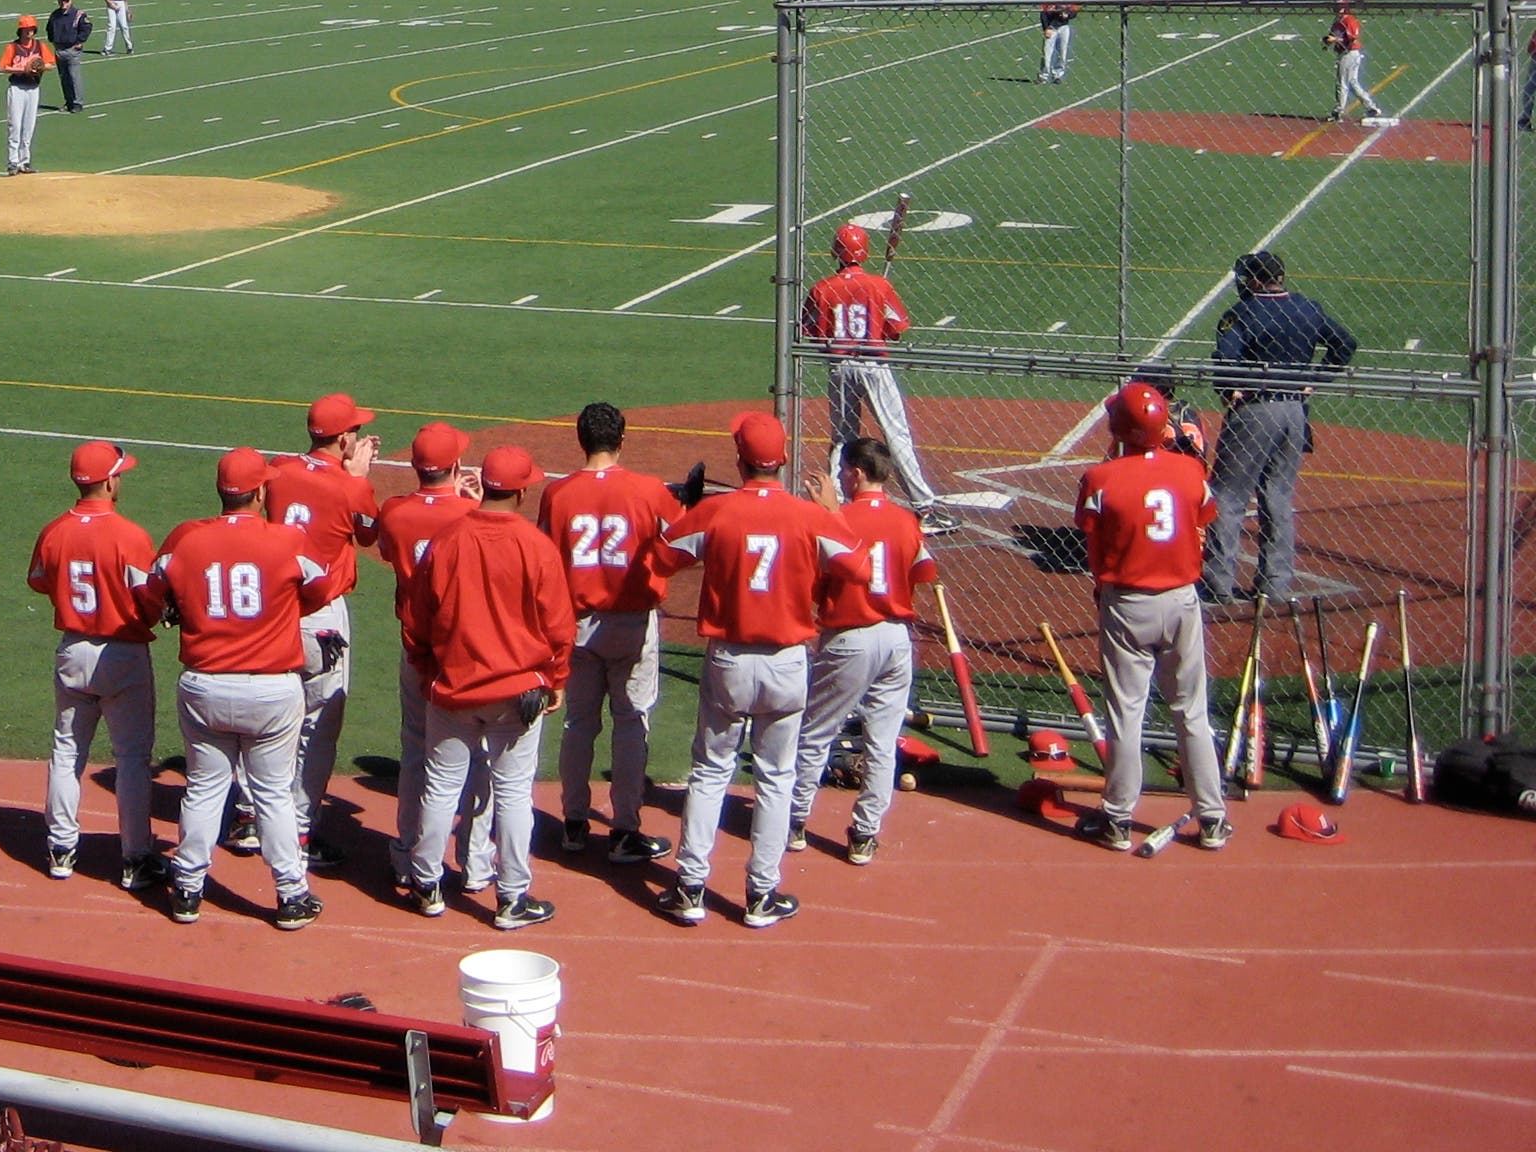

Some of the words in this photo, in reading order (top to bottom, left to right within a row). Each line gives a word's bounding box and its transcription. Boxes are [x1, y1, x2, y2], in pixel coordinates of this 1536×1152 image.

[833, 303, 868, 339] 16
[570, 514, 628, 568] 22
[1143, 488, 1177, 542] 3
[69, 559, 98, 614] 5
[204, 561, 263, 619] 18
[745, 534, 781, 592] 7
[867, 541, 890, 595] 1
